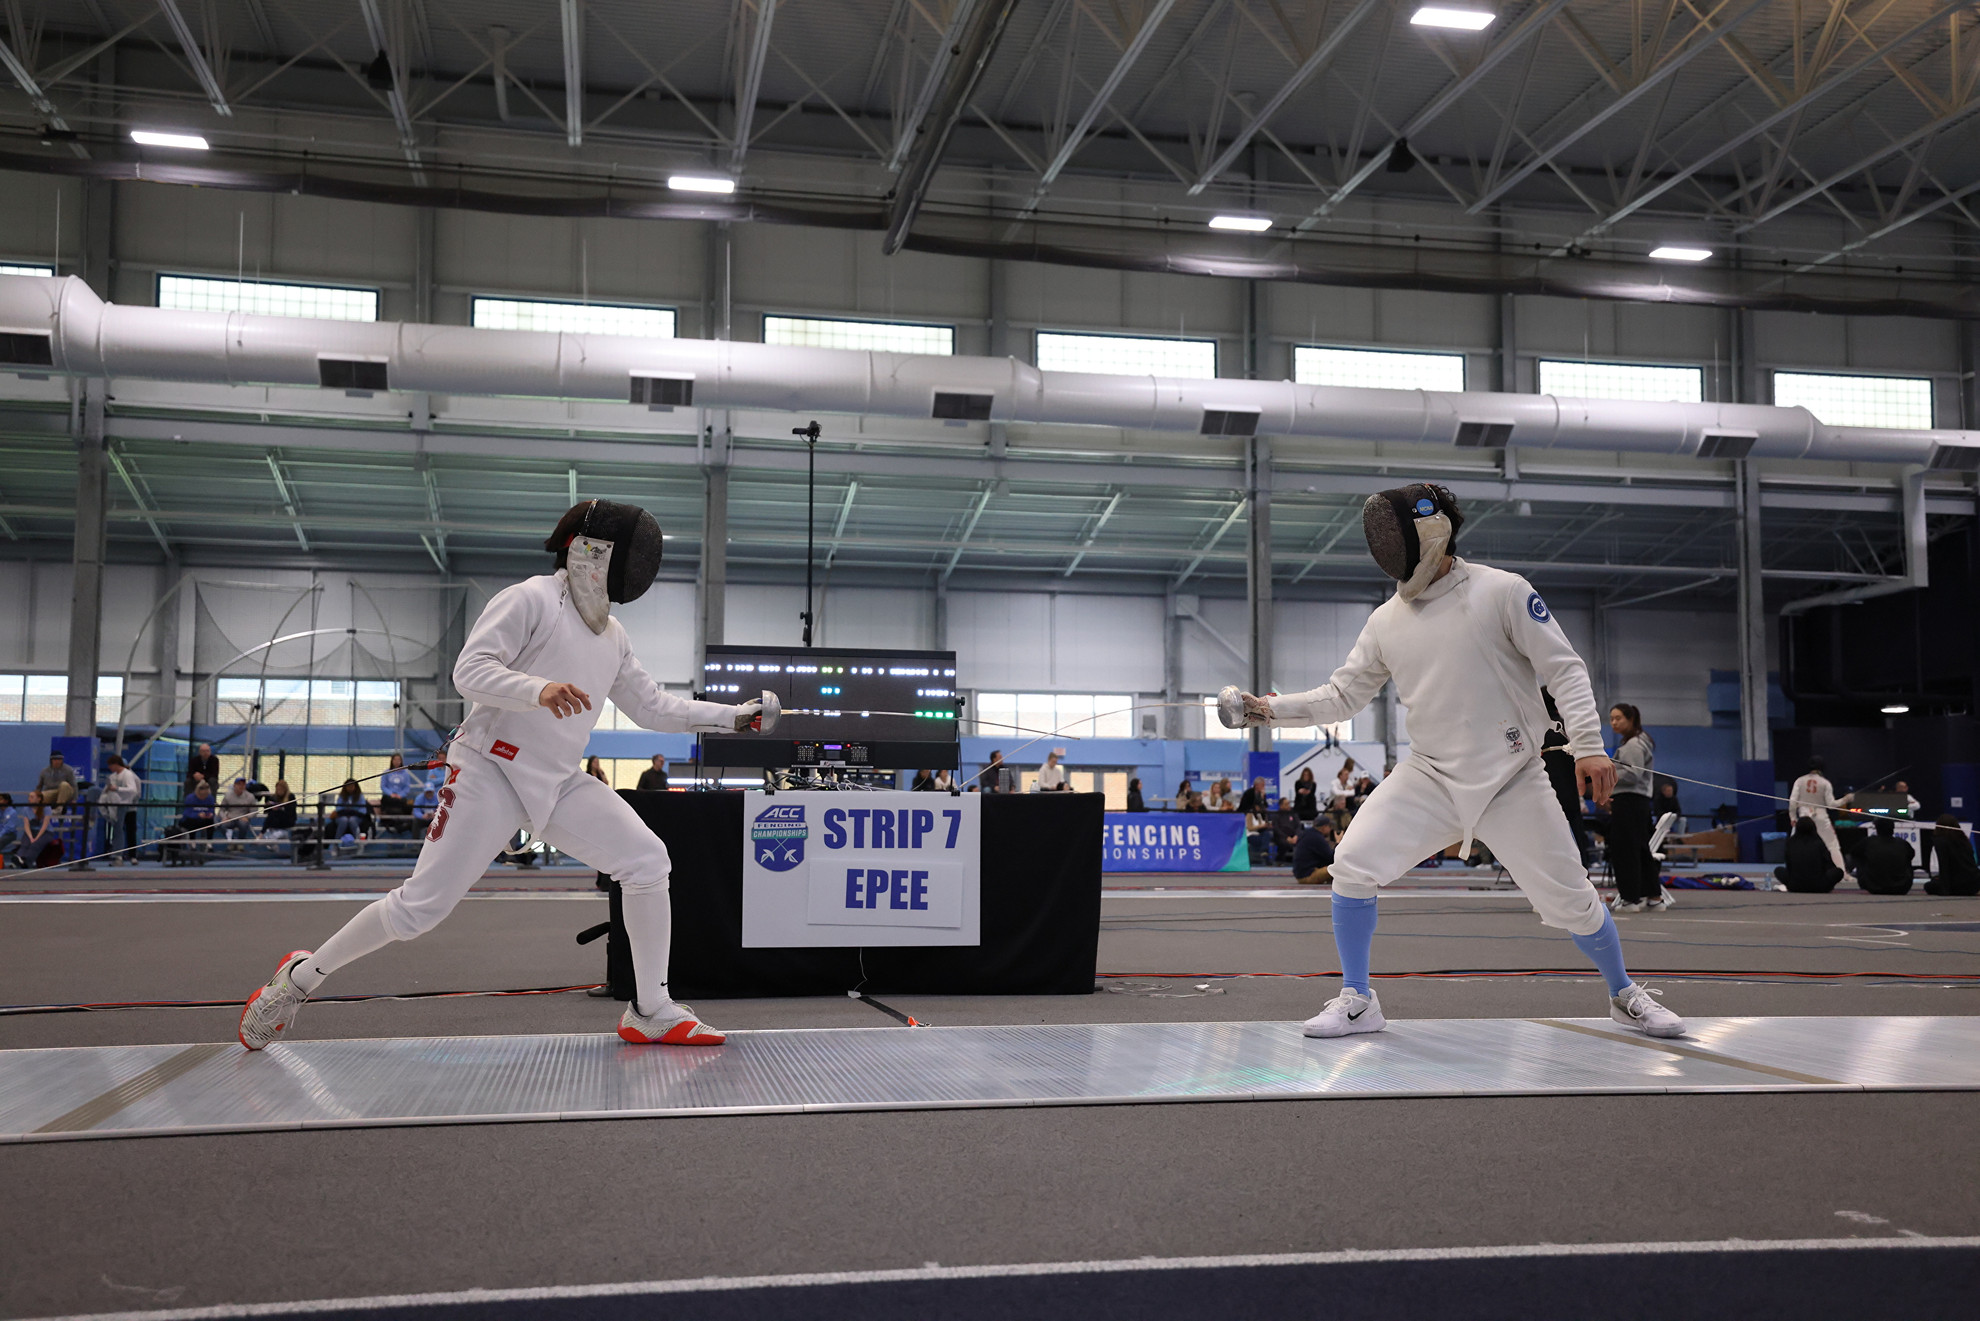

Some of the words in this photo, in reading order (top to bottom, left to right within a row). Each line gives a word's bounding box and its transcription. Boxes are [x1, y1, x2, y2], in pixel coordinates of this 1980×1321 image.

[764, 807, 801, 818] ACC
[753, 829, 807, 838] CHAMPIONSHIPS
[823, 808, 934, 850] STRIP
[942, 809, 962, 849] 7
[1103, 848, 1202, 860] IONSHIPS
[845, 869, 929, 910] EPEE
